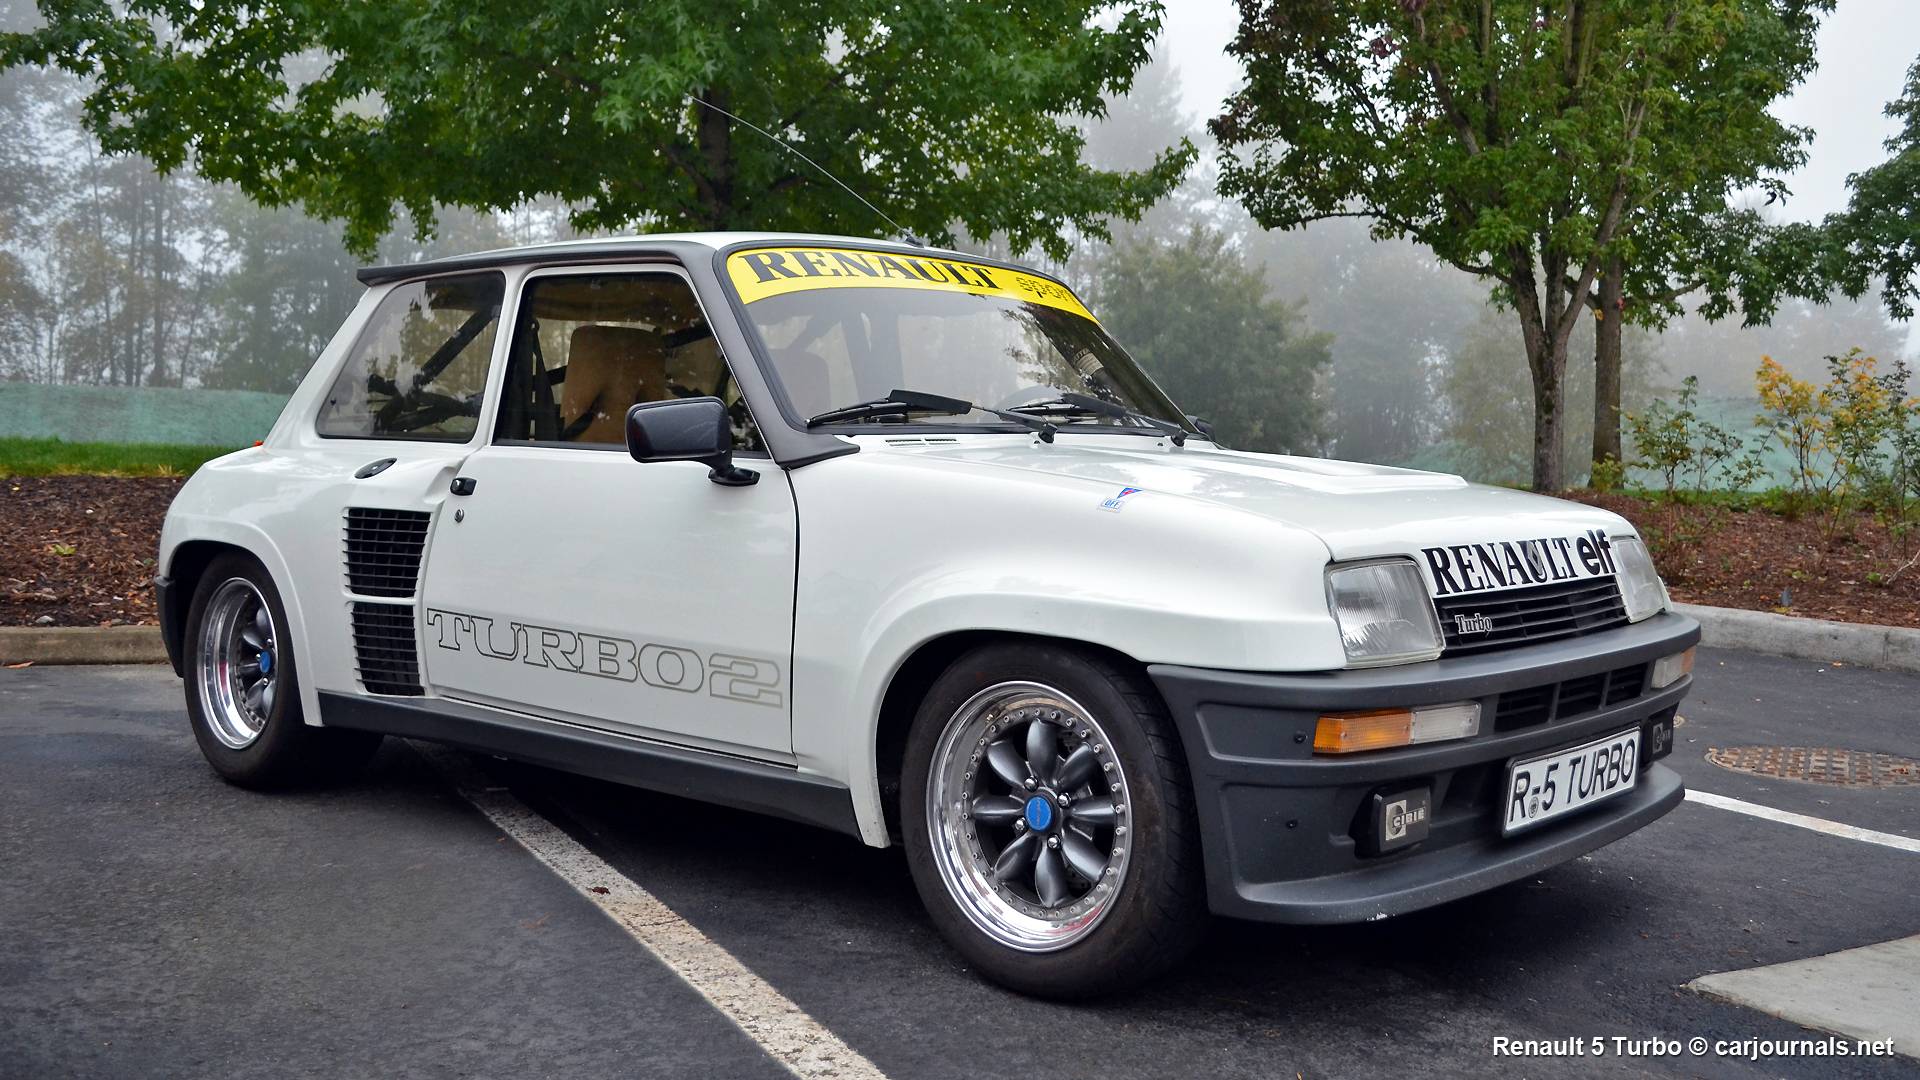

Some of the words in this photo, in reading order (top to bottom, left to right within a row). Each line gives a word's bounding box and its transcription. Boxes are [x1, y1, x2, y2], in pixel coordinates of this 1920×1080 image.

[740, 250, 1003, 290] RENAULT
[1421, 536, 1579, 596] RENAULT
[1576, 528, 1617, 576] elf
[1454, 612, 1493, 635] Turbo
[1509, 763, 1560, 823] R-5
[1565, 738, 1636, 804] TURBO
